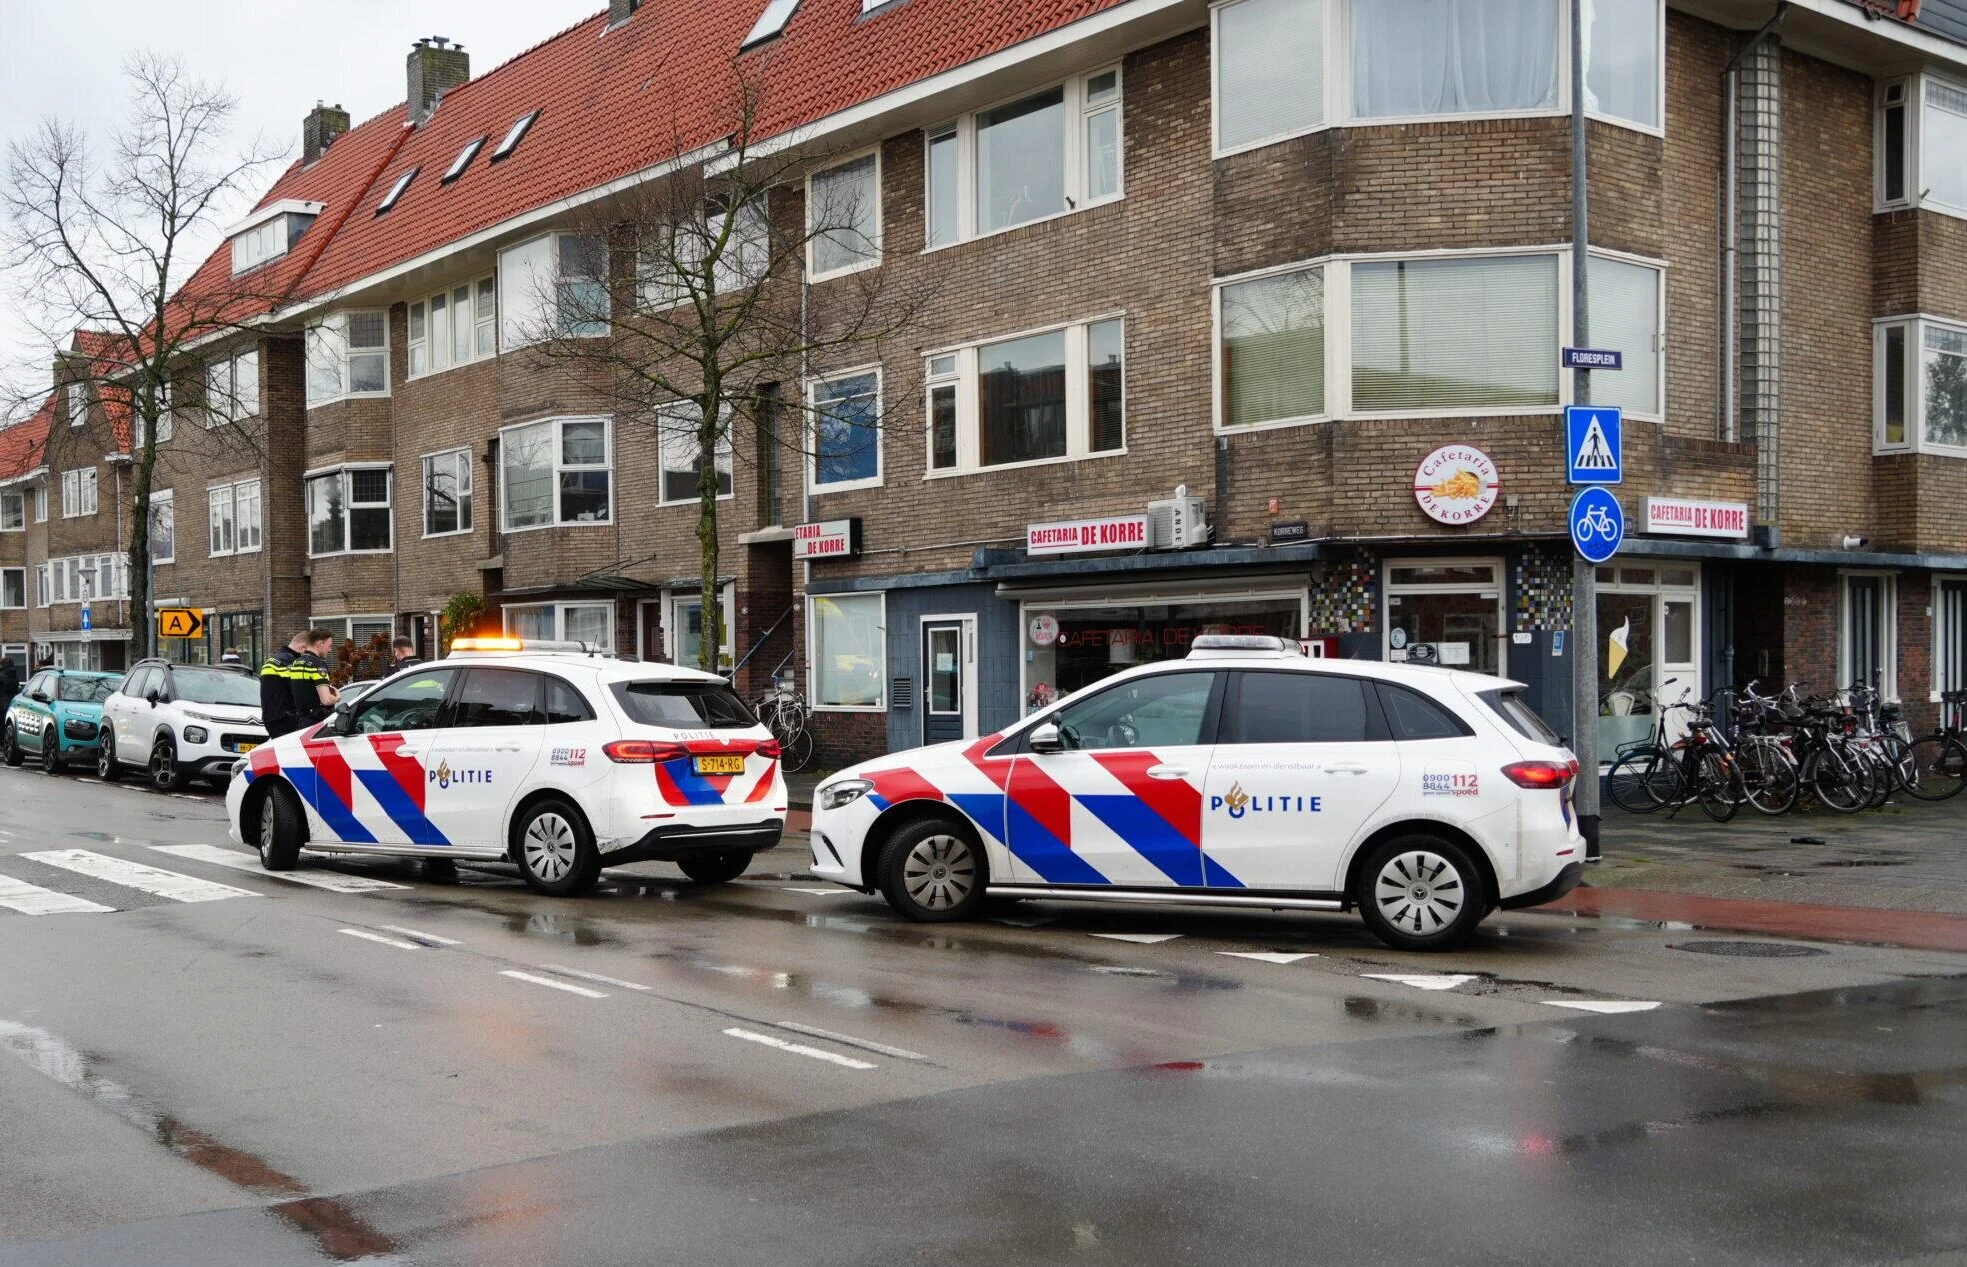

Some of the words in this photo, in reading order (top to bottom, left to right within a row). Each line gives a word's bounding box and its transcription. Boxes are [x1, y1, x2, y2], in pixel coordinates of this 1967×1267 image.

[1571, 352, 1616, 365] FLORESPLEIN
[1423, 451, 1490, 477] Cafetaria
[1421, 494, 1439, 512] DE
[1440, 495, 1491, 521] KORRE
[1651, 504, 1693, 523] CAFETARIA
[1695, 507, 1707, 529] DE
[1710, 508, 1744, 531] KORRE
[1031, 527, 1078, 544] CAFETARIA
[1081, 526, 1097, 545] DE
[1100, 522, 1144, 544] KORRE
[1273, 526, 1304, 537] KORREWEG
[807, 541, 817, 555] DE
[819, 539, 845, 554] KORRE
[169, 615, 183, 631] A
[1057, 628, 1155, 648] CAFETARIA
[673, 731, 716, 740] POLITIE
[569, 748, 587, 759] 112
[701, 758, 741, 771] S-714-RG
[429, 770, 492, 789] POLITIE
[1423, 774, 1450, 782] 0900
[1451, 774, 1478, 787] 112
[1452, 788, 1479, 797] spoed
[1211, 795, 1321, 819] POLITIE
